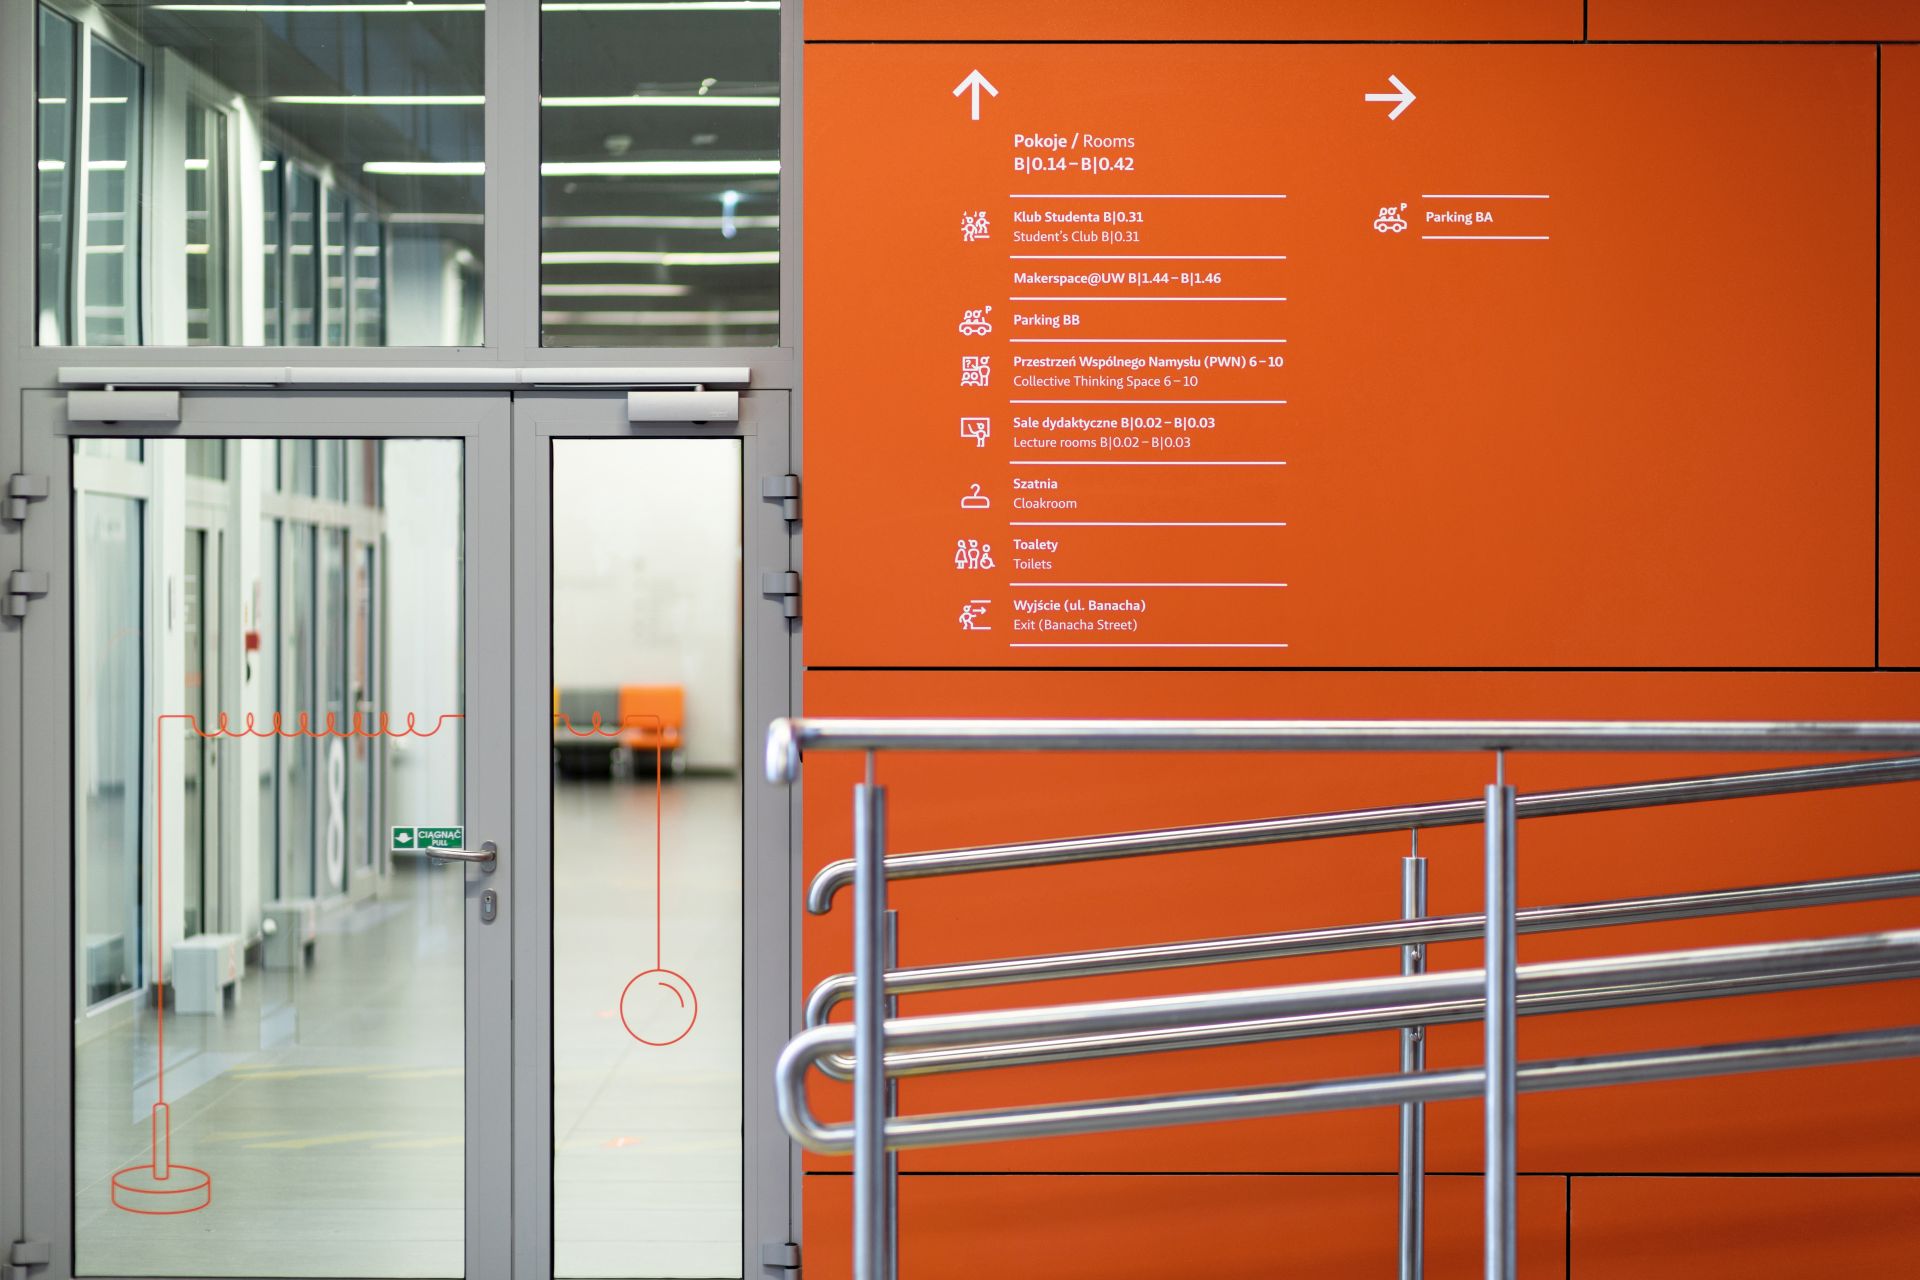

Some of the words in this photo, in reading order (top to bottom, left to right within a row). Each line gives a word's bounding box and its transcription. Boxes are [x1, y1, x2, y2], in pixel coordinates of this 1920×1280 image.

[1013, 132, 1068, 152] Pokoje
[1082, 133, 1135, 148] Rooms
[1013, 210, 1043, 224] Klub
[1044, 210, 1101, 224] Studenta
[1103, 210, 1144, 226] B|0.31
[1425, 210, 1473, 226] Parking
[1475, 211, 1494, 223] BA
[1071, 230, 1099, 243] Club
[1101, 230, 1140, 245] B|0.31
[1013, 271, 1126, 287] Makerspace@UW
[1013, 313, 1061, 329] Parking
[1062, 313, 1081, 326] BB
[1013, 354, 1077, 368] Przestrzeń
[1078, 354, 1147, 371] Wspólnego
[1148, 355, 1202, 371] Namysłu
[1203, 355, 1247, 370] (PWN)
[1013, 375, 1071, 387] Collective
[1073, 375, 1124, 390] Thinking
[1126, 375, 1161, 390] Space
[1013, 416, 1040, 429] Sale
[1041, 416, 1119, 432] dydaktyczne
[1013, 436, 1057, 448] Lecture
[1059, 439, 1097, 448] rooms
[1012, 477, 1059, 490] Szatnia
[1013, 497, 1078, 509] Cloakroom
[1012, 538, 1059, 553] Toalety
[1012, 557, 1053, 570] Toilets
[1013, 599, 1062, 614] Wyjście
[1063, 599, 1086, 613] (ul.
[1087, 599, 1147, 613] Banacha)
[1013, 618, 1036, 631] Exit
[1038, 618, 1094, 632] (Banacha
[1096, 618, 1138, 632] Street)
[418, 829, 462, 841] CIĄGNĄĆ
[431, 839, 449, 847] PULL
